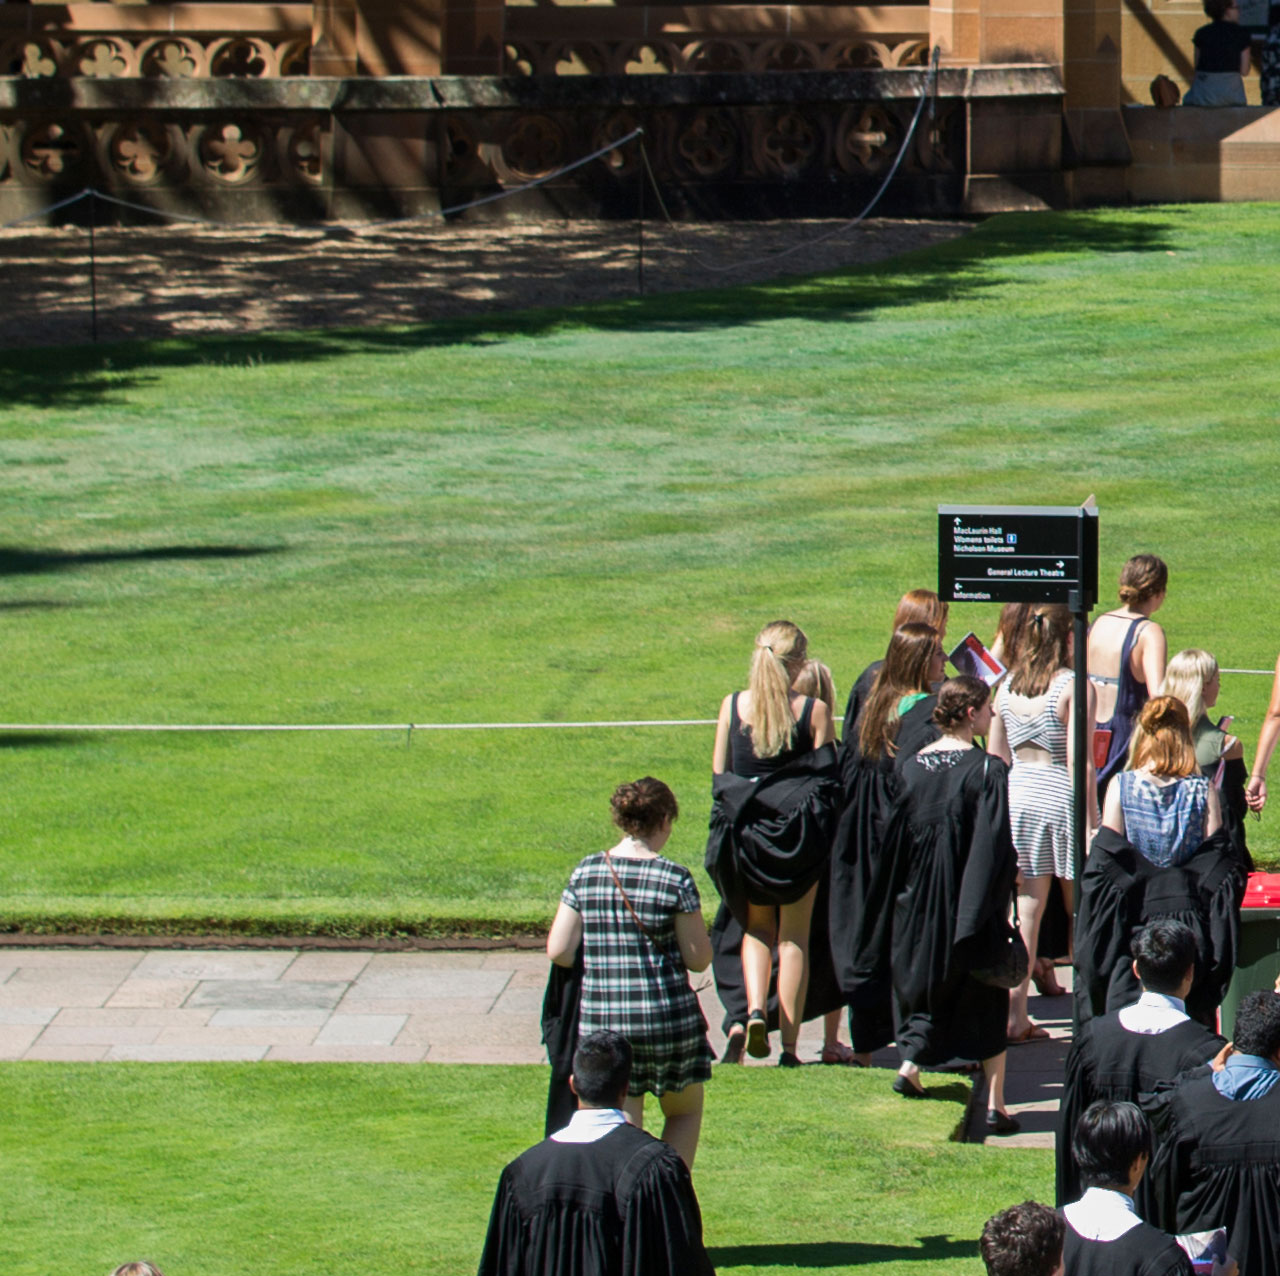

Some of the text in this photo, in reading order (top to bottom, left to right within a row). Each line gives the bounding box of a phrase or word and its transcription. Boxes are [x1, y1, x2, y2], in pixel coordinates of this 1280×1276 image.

[953, 527, 1002, 535] MacLaurin Hall
[983, 536, 1004, 544] toilets
[987, 567, 1065, 577] General Lecture Theatre
[953, 592, 991, 600] Information
